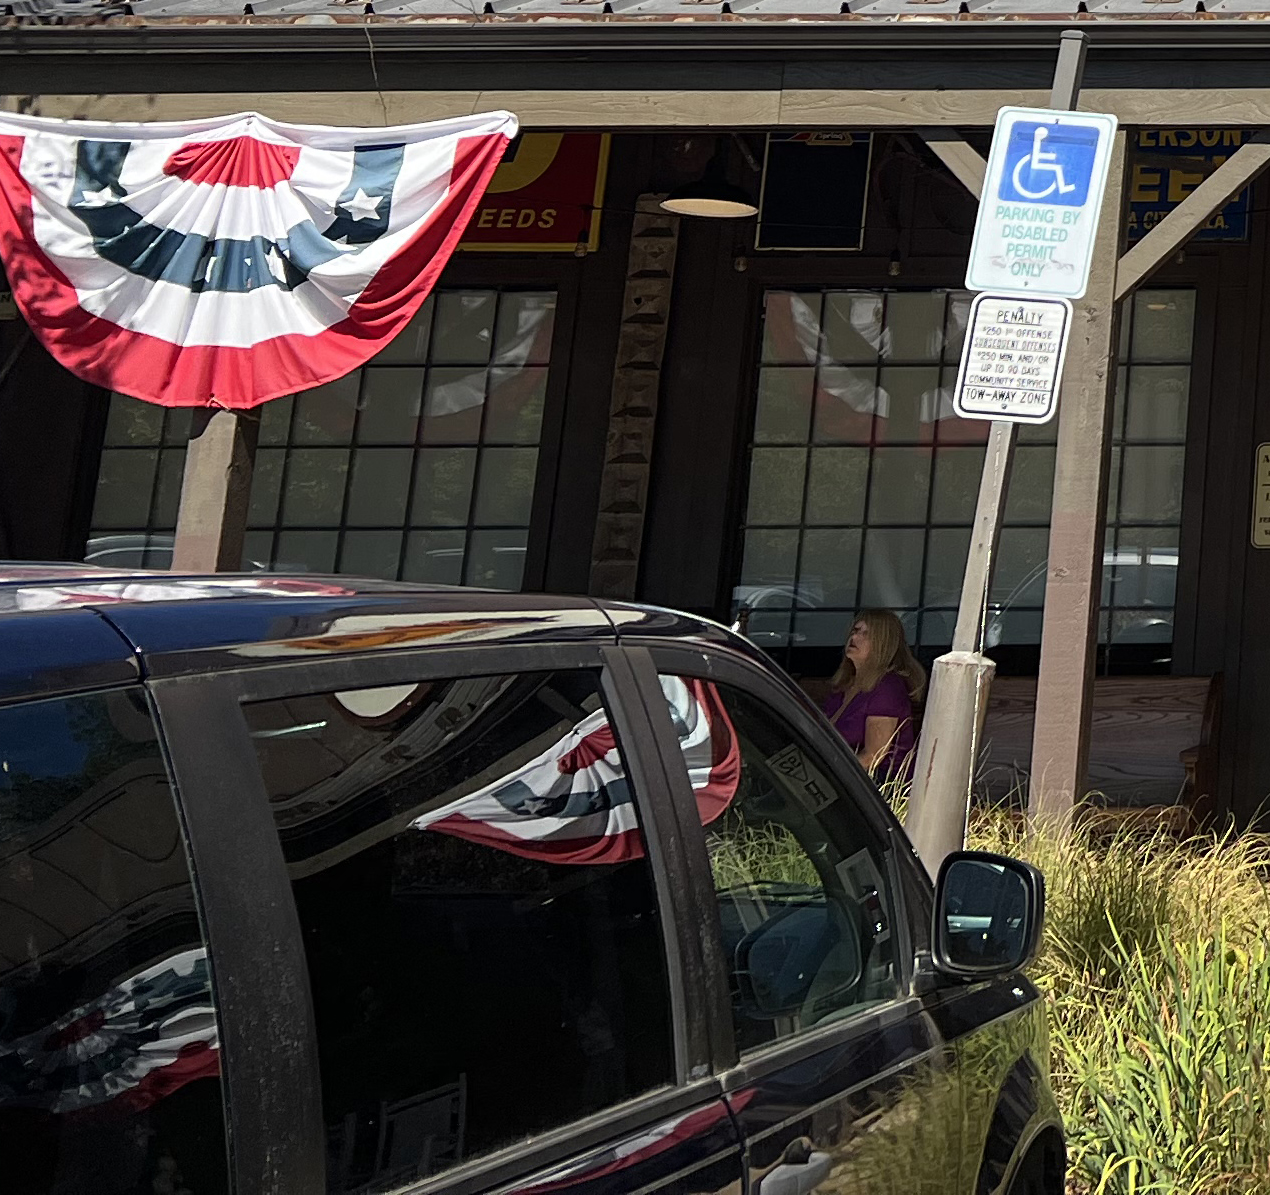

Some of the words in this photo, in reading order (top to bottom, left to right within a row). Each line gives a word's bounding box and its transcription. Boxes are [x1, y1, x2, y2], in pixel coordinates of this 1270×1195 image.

[473, 208, 557, 228] EEDS
[995, 205, 1055, 224] PARKING
[1062, 210, 1081, 225] BY
[1001, 223, 1069, 242] DISABLED
[1006, 242, 1057, 260] PERMIT
[1010, 261, 1046, 278] ONLY
[997, 310, 1044, 325] PENALTY
[1016, 328, 1053, 340] OFFENSE
[980, 363, 992, 373] UP
[995, 364, 1005, 374] TO
[1008, 365, 1018, 375] 90
[969, 374, 1014, 385] COMMUNITY
[1016, 378, 1049, 389] SERVICE
[966, 388, 1017, 403] TOW-AWAY
[1020, 391, 1047, 405] ZONE
